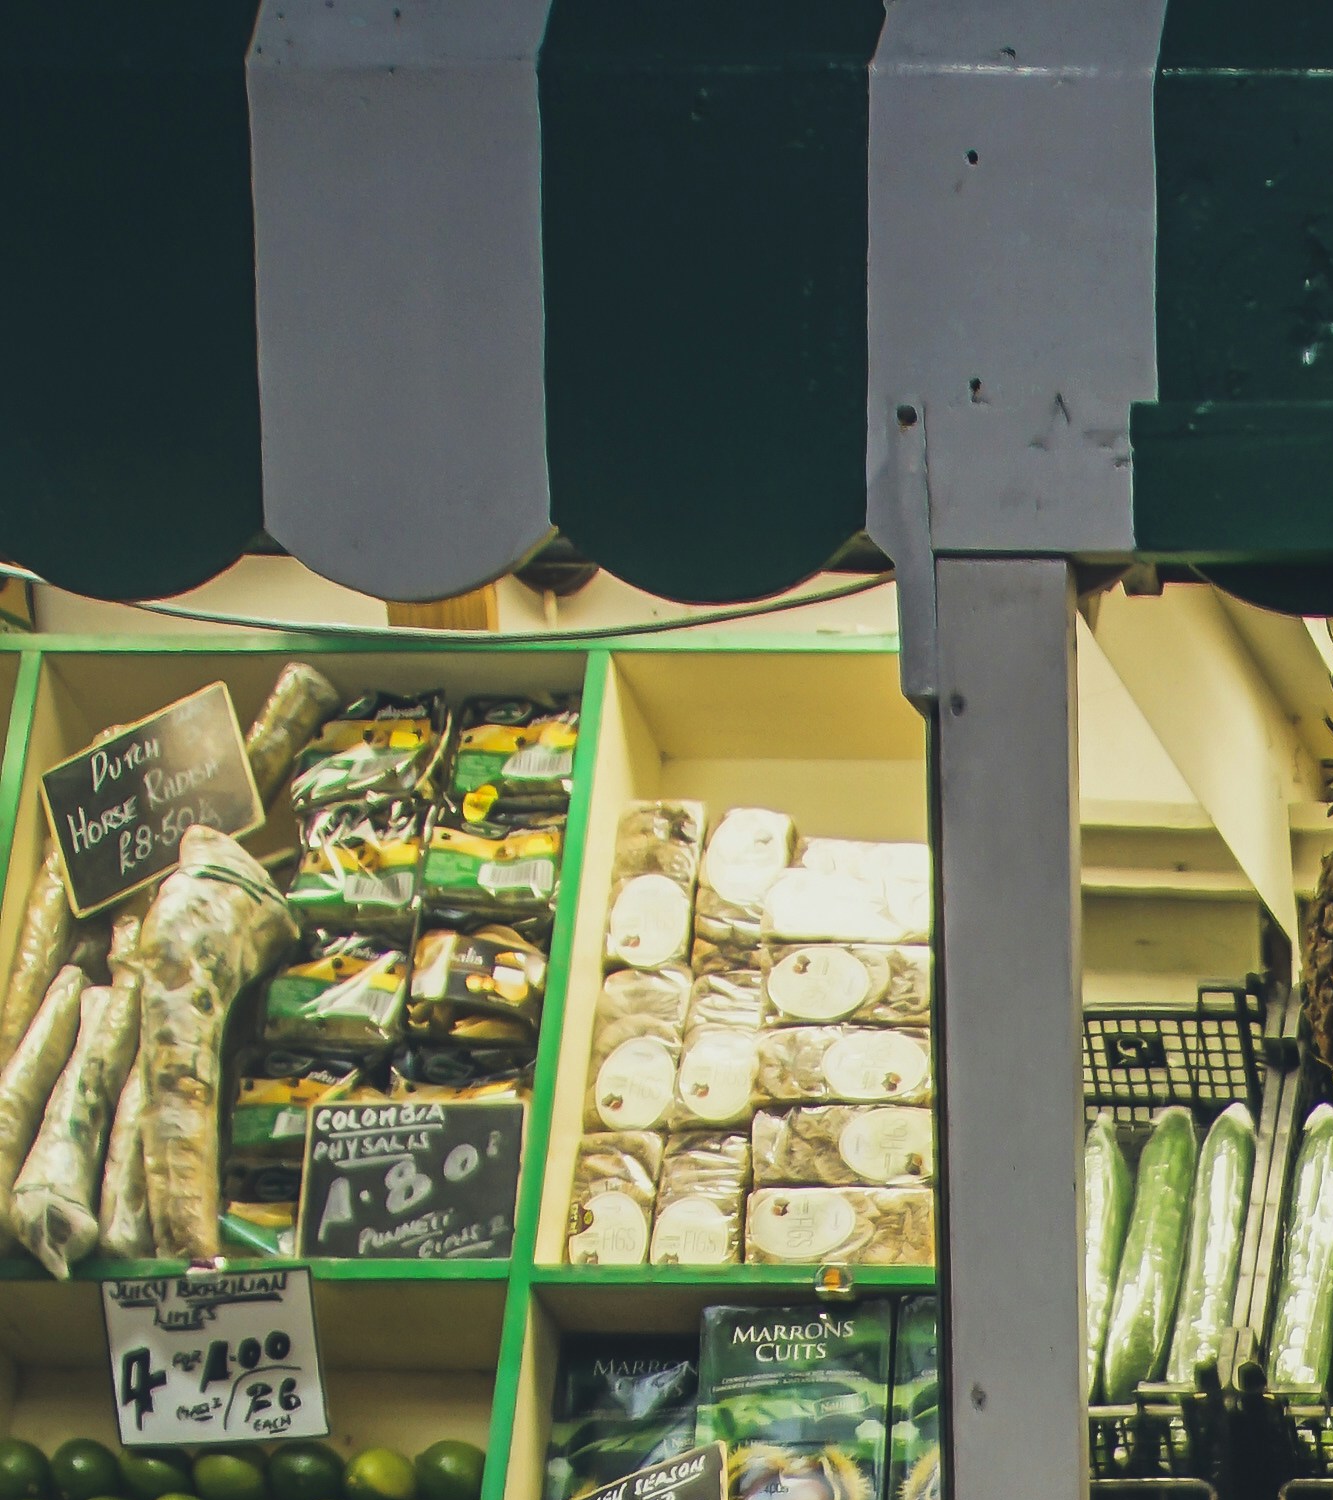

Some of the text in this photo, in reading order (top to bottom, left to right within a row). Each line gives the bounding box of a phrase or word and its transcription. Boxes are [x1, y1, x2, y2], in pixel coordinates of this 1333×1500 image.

[67, 796, 137, 853] HORSE
[316, 1103, 444, 1131] COLOMBIA
[732, 1320, 855, 1345] MARRONS
[755, 1343, 828, 1363] CUITS
[634, 1455, 706, 1495] SEASON
